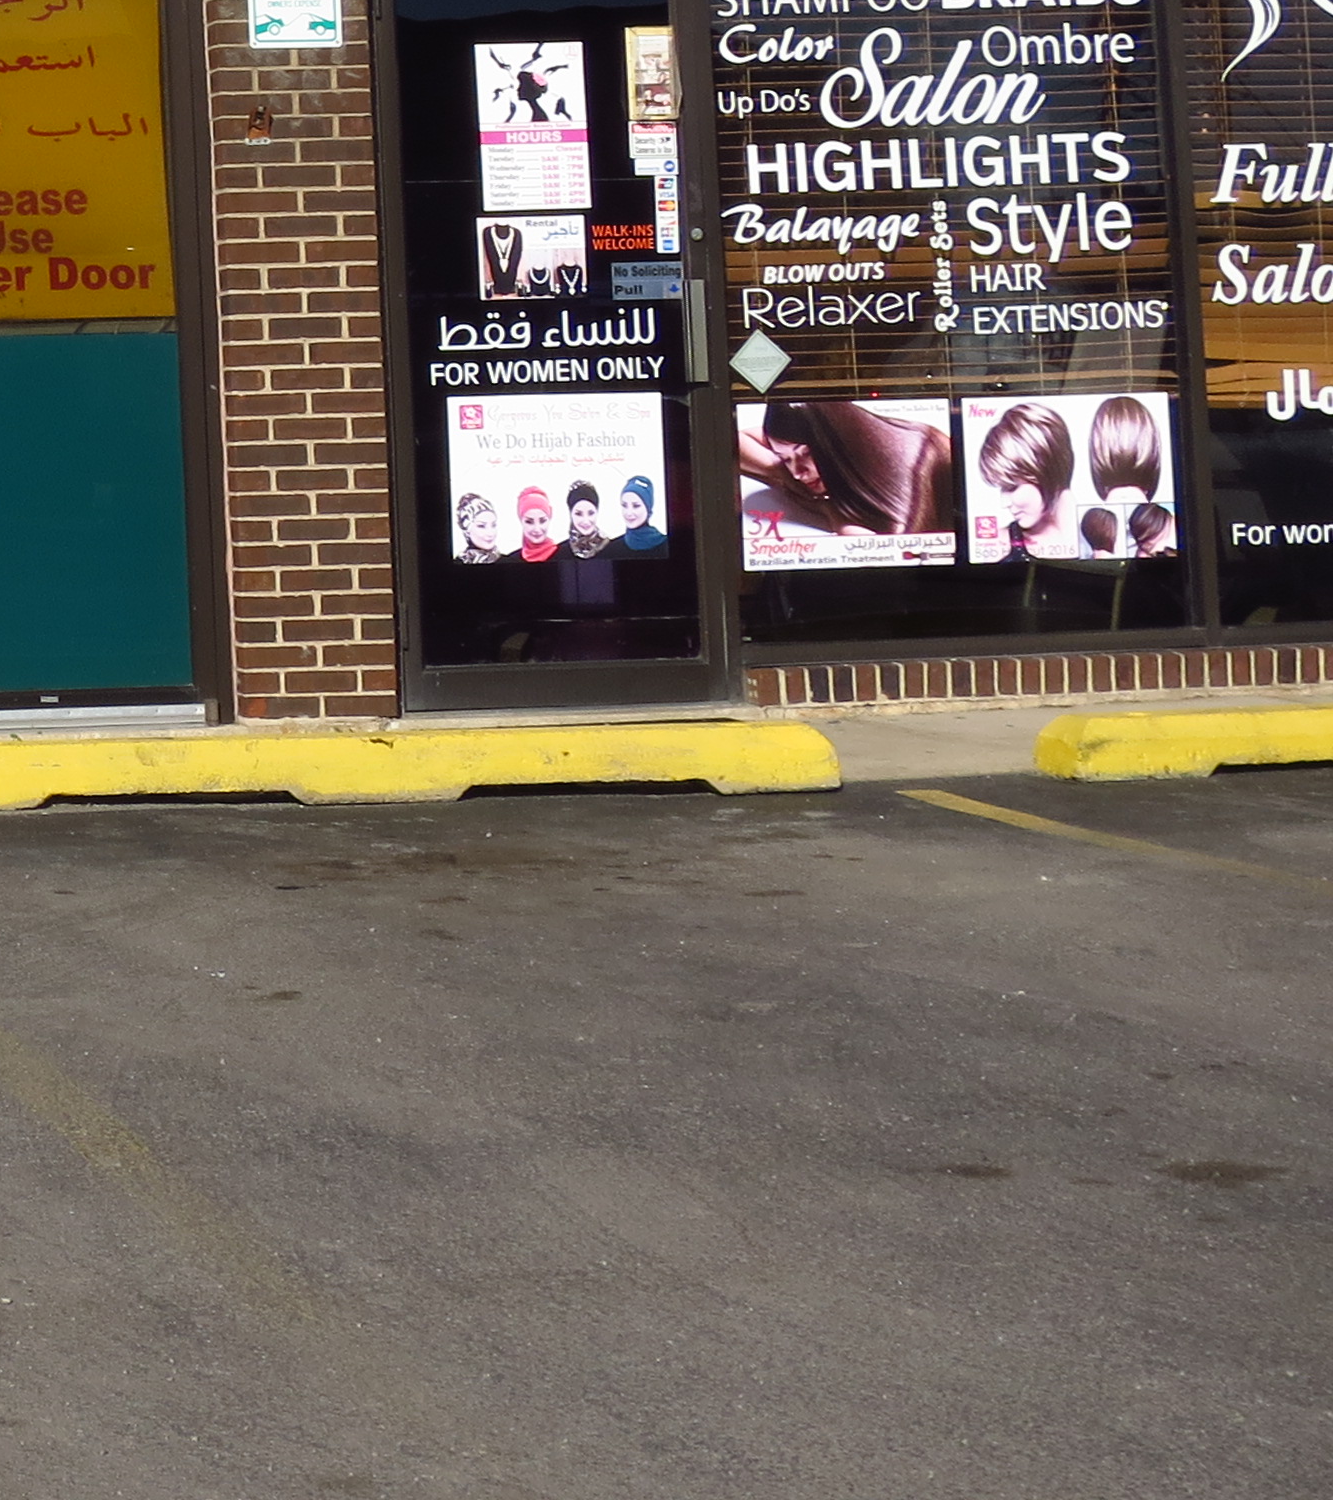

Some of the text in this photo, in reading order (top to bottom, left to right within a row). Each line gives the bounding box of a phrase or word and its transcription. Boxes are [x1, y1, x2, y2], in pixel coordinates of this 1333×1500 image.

[718, 23, 834, 64] Color
[981, 23, 1135, 67] Ombre
[820, 27, 1046, 129] Salon
[717, 88, 811, 119] Up Do's
[27, 113, 149, 142] الباب
[506, 131, 562, 143] HOURS
[747, 131, 1130, 194] HIGHLIGHTS
[525, 220, 558, 228] Rental
[592, 224, 654, 238] WALK-INS
[720, 203, 921, 254] Balayage
[965, 192, 1134, 262] Style
[592, 238, 654, 250] WELCOME
[48, 257, 155, 291] Door
[614, 265, 682, 279] No Soliciting
[762, 262, 885, 284] BLOW OUTS
[930, 200, 960, 333] Roller Sets
[969, 264, 1046, 292] HAIR
[614, 285, 643, 295] Pull
[742, 286, 921, 329] Relaxer
[973, 300, 1165, 336] EXTENSIONS
[437, 307, 656, 351] للنساء فقط
[430, 356, 665, 387] FOR WOMEN ONLY
[968, 404, 997, 418] New
[476, 431, 636, 452] We Do Hijab Fashion
[1232, 523, 1276, 546] For
[749, 539, 818, 559] Smoother
[749, 555, 895, 567] Brazilian Keratin Treatment
[1048, 545, 1076, 556] 2016
